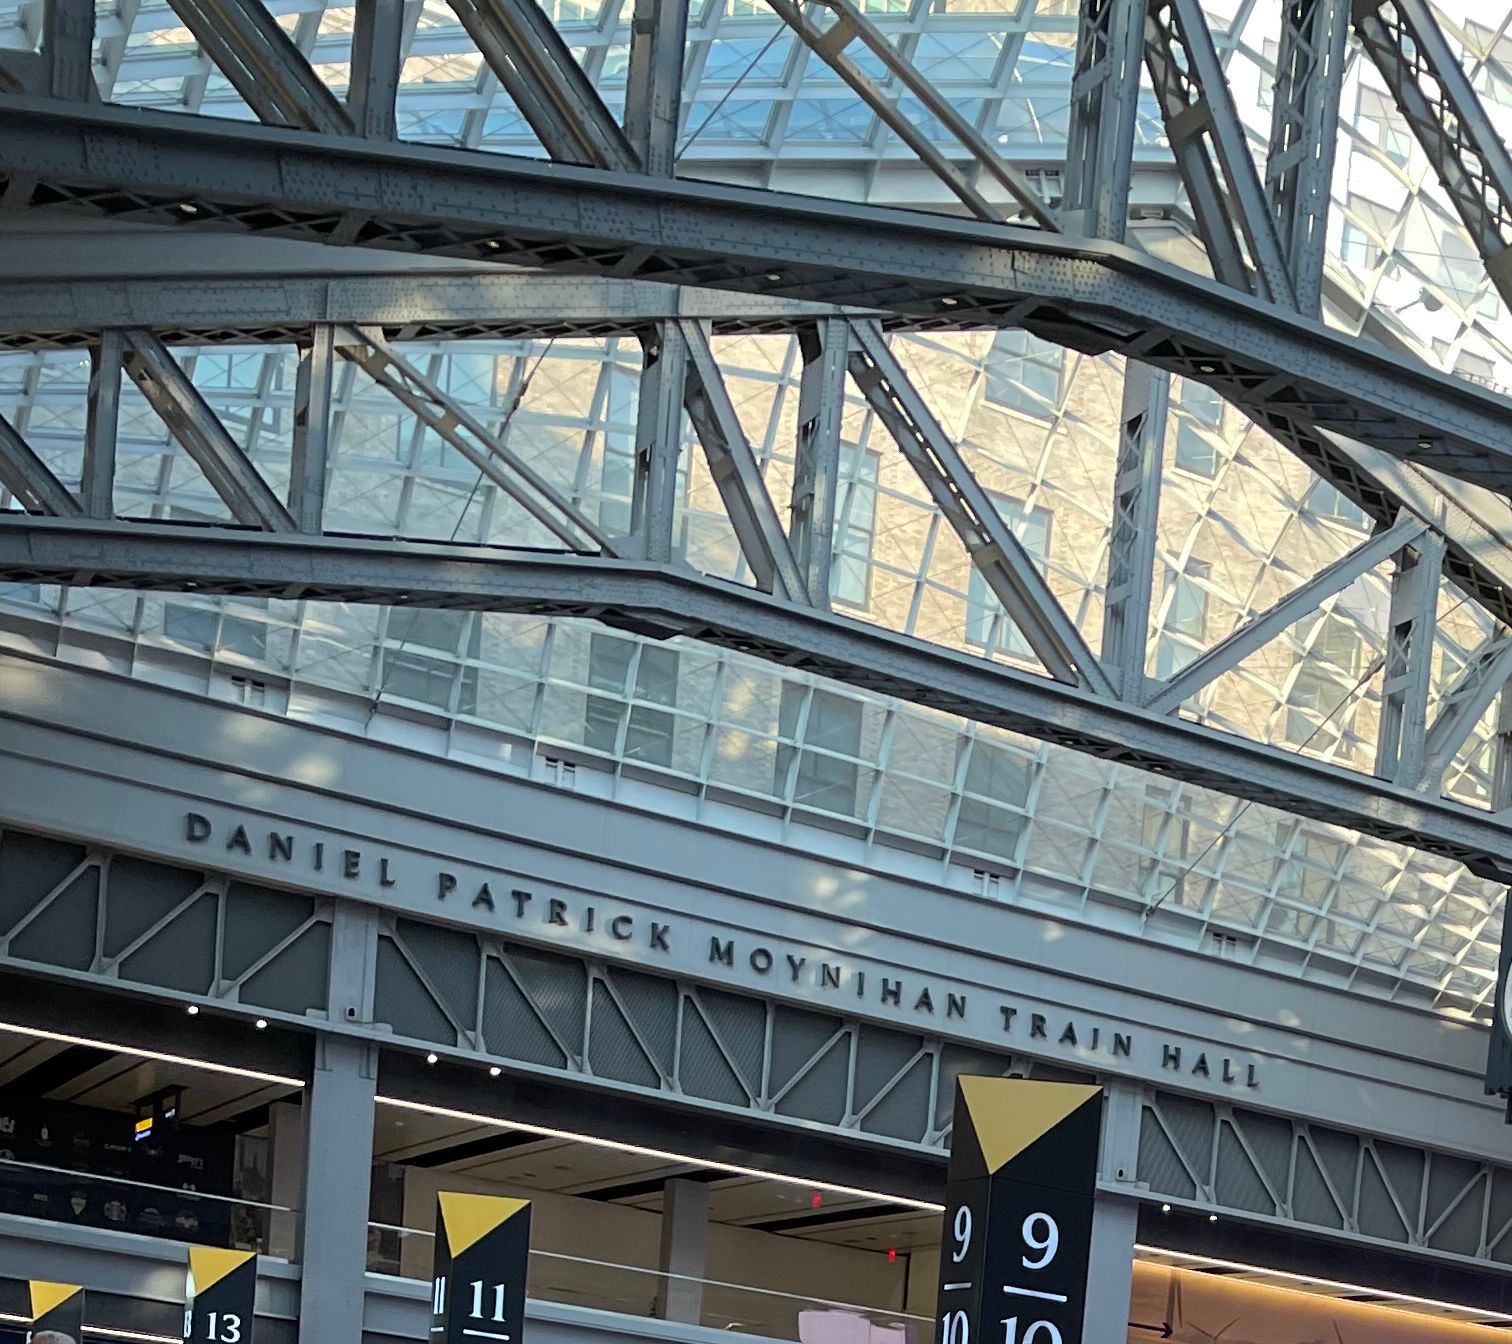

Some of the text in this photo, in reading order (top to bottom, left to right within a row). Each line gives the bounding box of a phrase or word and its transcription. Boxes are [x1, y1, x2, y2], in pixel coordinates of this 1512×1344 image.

[186, 812, 1262, 1089] DANIEL PATRICK MOYNIHAN TRAIN HALL
[952, 1204, 972, 1263] 9
[1021, 1211, 1060, 1271] 9
[433, 1276, 446, 1315] 11
[468, 1280, 506, 1322] 11
[207, 1311, 240, 1343] 13
